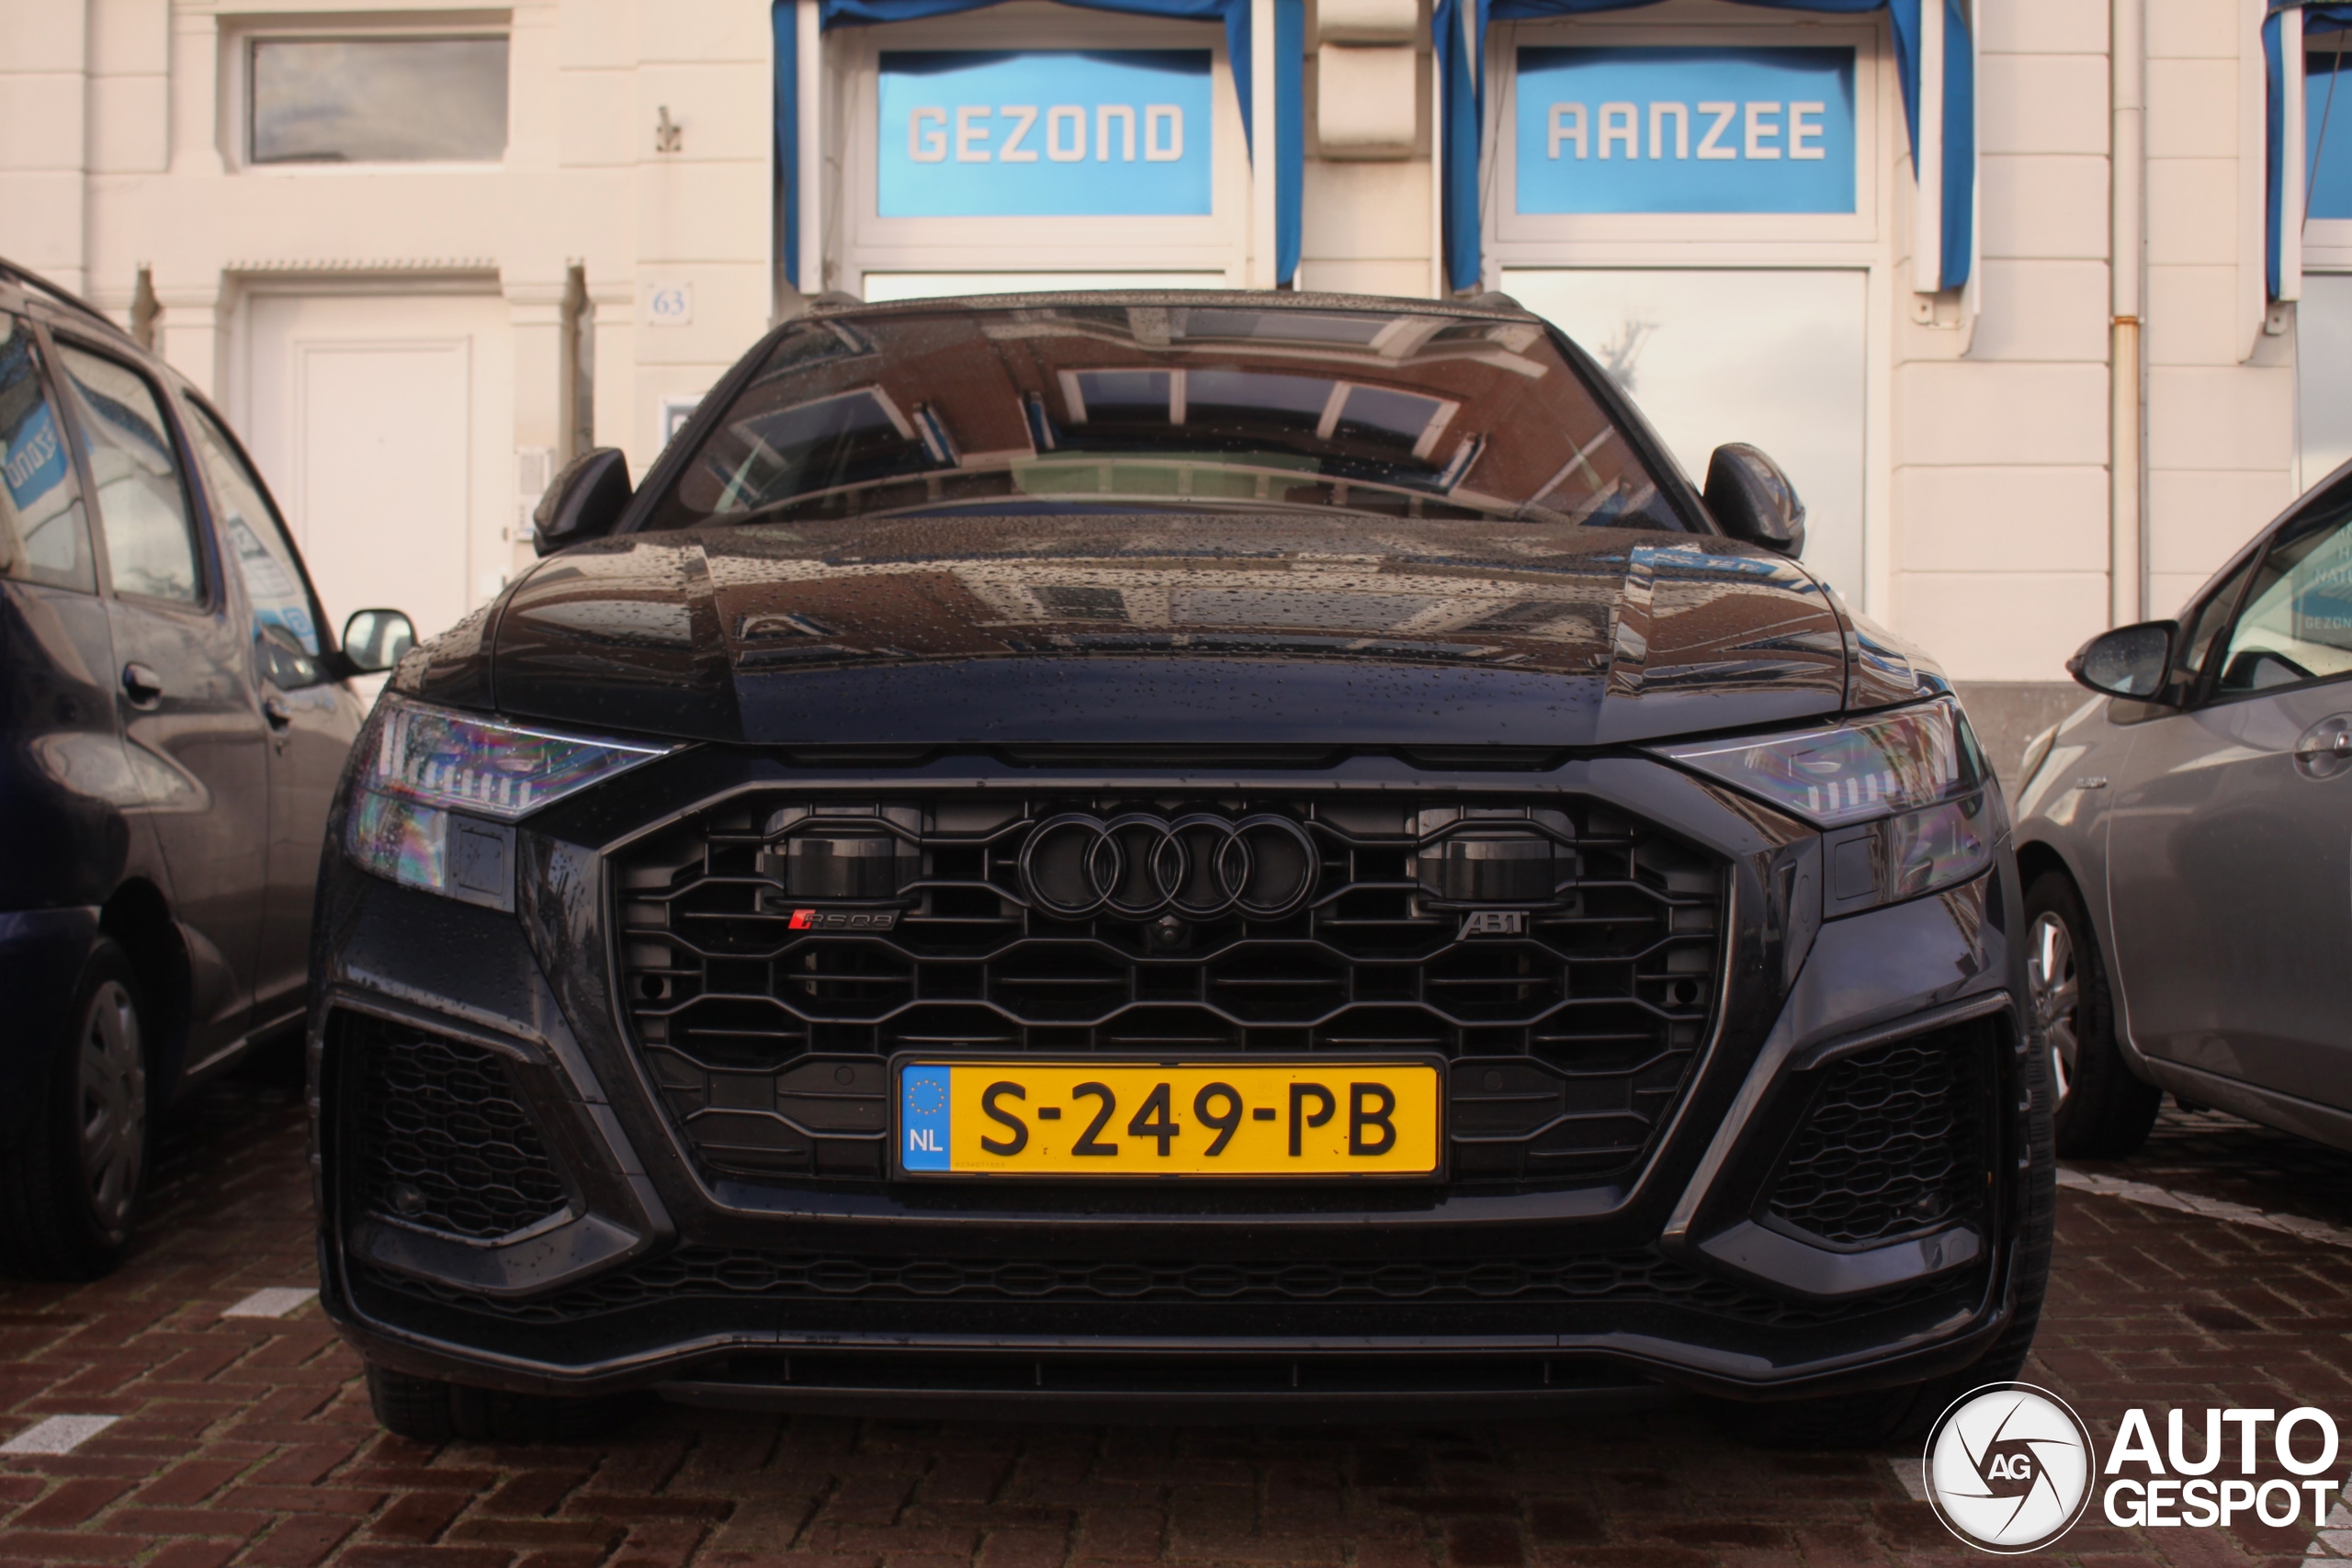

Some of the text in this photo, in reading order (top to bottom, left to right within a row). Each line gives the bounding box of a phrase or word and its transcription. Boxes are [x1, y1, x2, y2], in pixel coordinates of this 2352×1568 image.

[909, 104, 1183, 163] GEZOND
[1548, 101, 1825, 160] AANZEE
[653, 289, 684, 315] 63
[1455, 911, 1530, 941] ABT
[910, 1129, 944, 1152] NL
[980, 1081, 1396, 1156] S-249-PB
